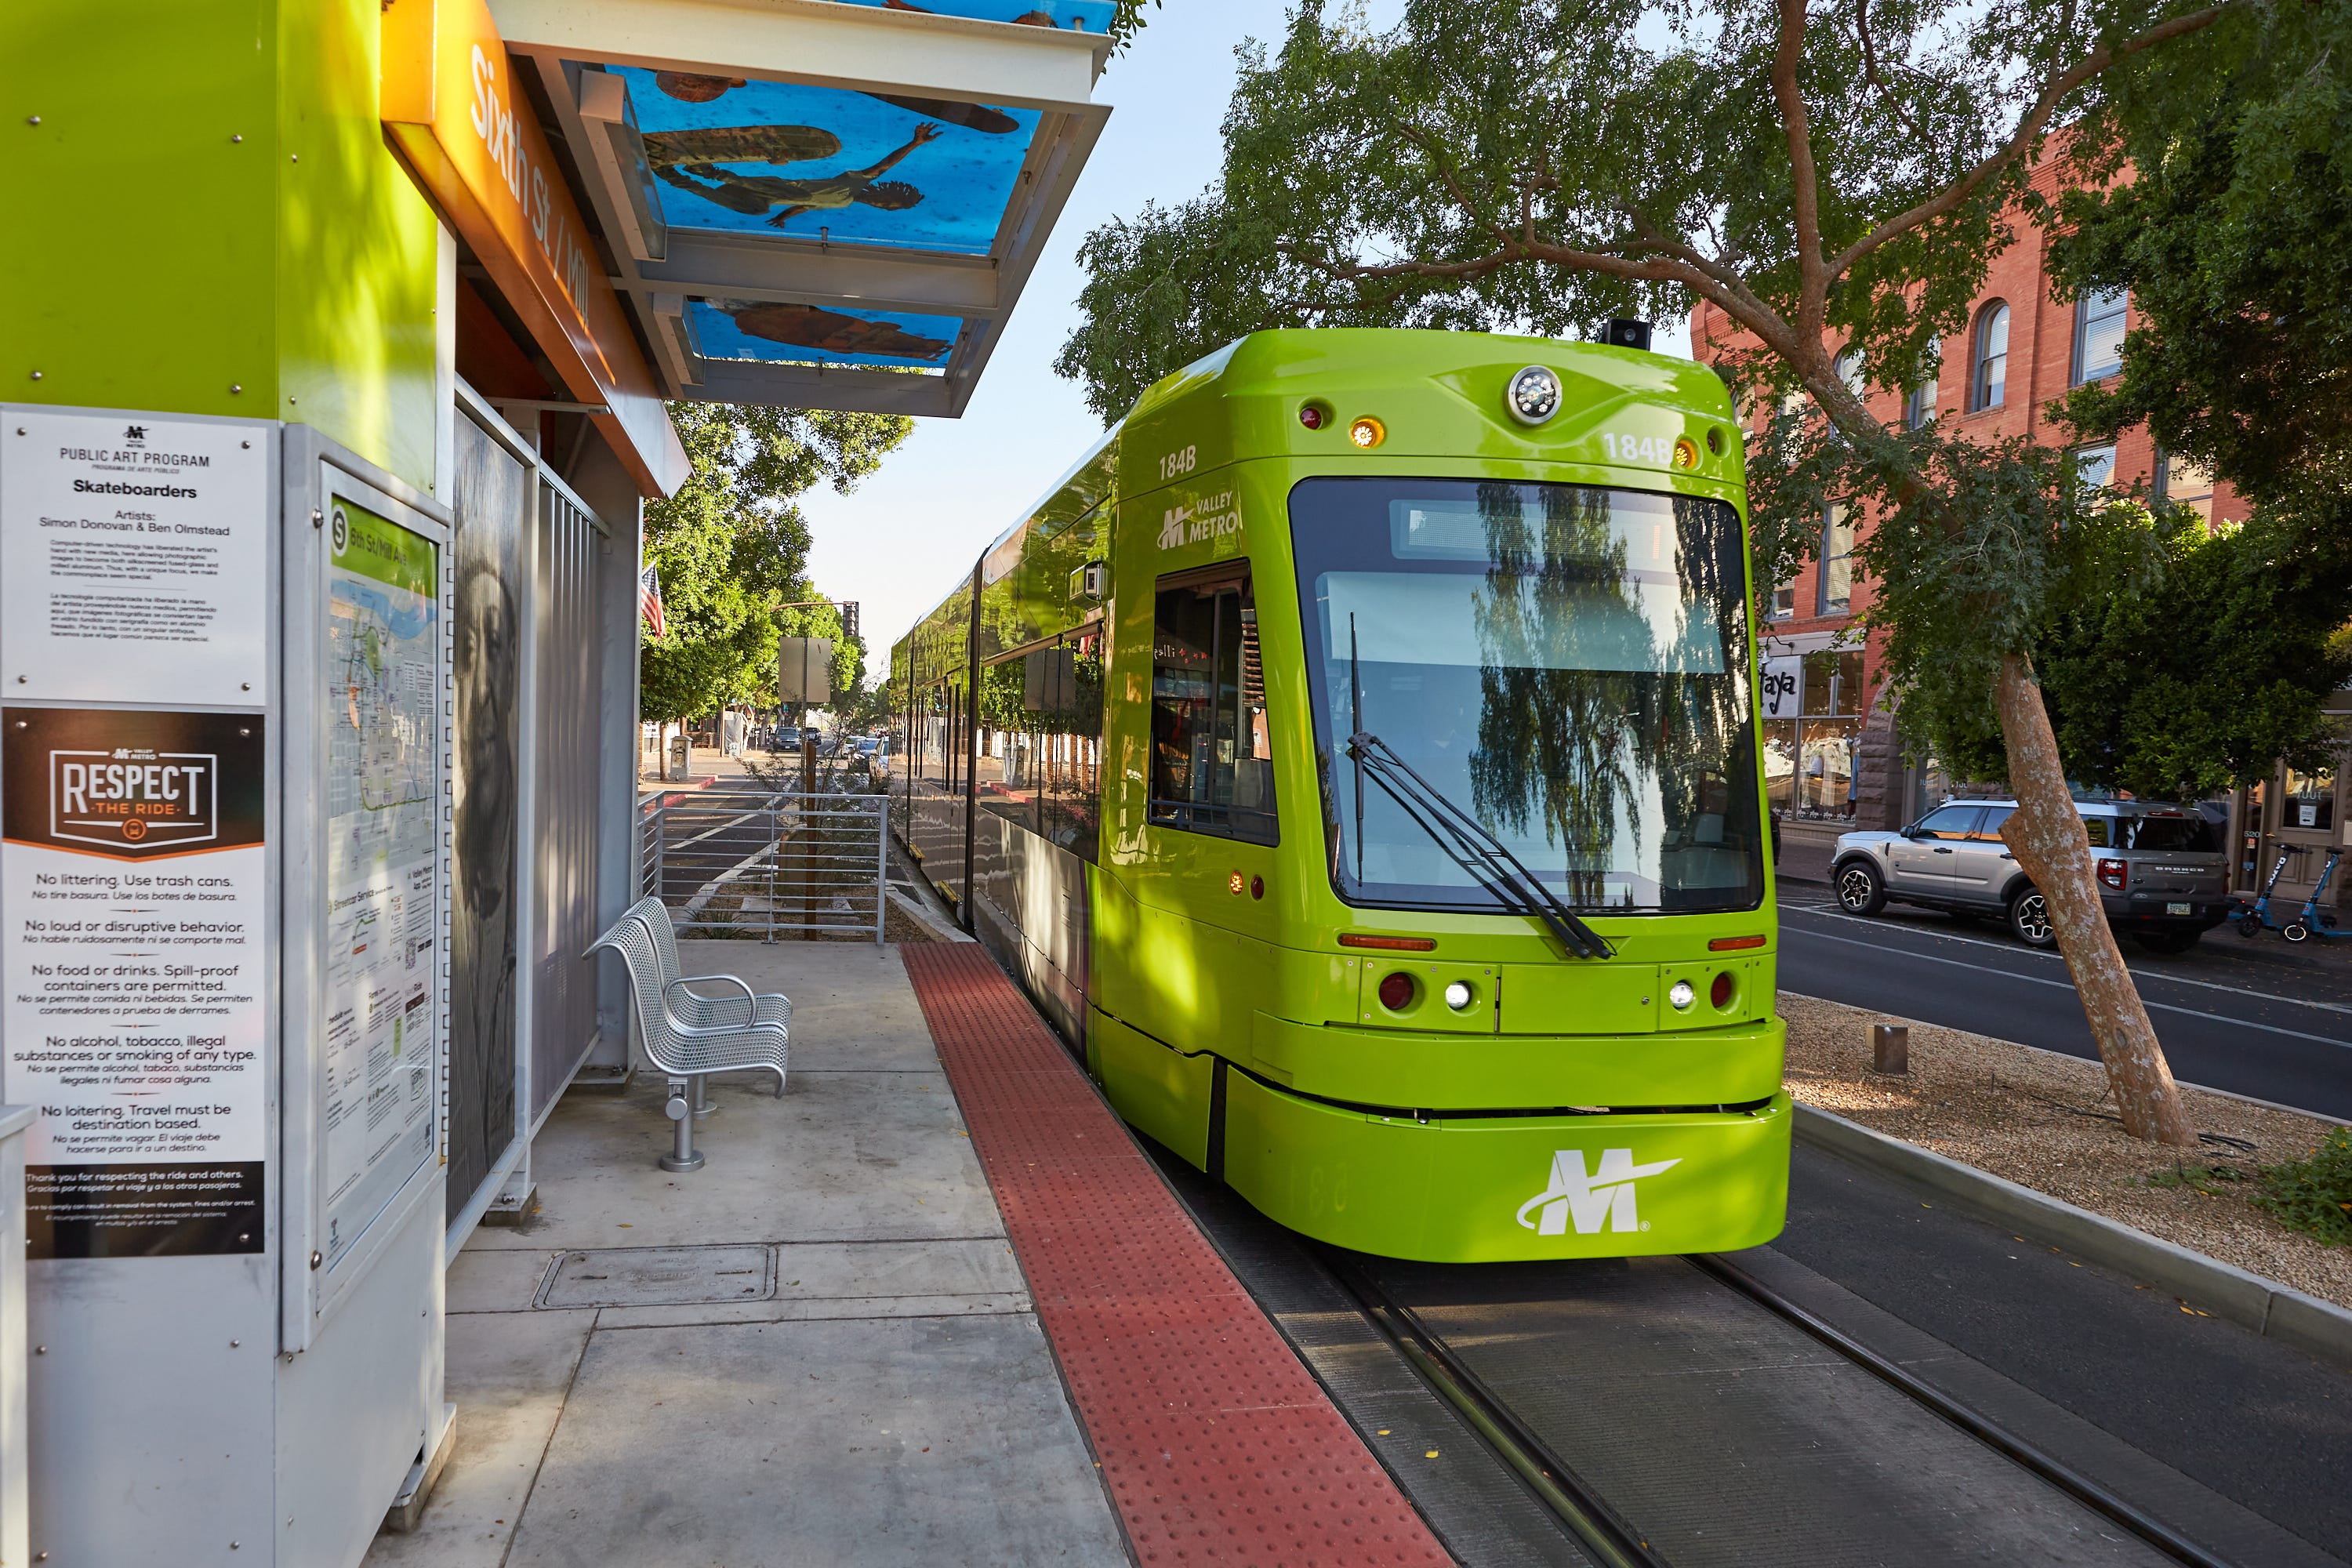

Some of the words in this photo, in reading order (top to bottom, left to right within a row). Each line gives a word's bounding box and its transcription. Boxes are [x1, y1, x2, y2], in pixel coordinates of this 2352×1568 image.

[470, 43, 528, 217] Sixth
[532, 165, 550, 258] St
[554, 214, 564, 281] /
[567, 231, 589, 328] Mill
[1603, 432, 1672, 464] 184B
[60, 447, 108, 462] PUBLIC
[112, 450, 138, 463] ART
[143, 452, 209, 467] PROGRAM
[1160, 445, 1196, 481] 184B
[73, 478, 198, 499] Skateboarders
[1196, 491, 1232, 514] VALLEY
[114, 510, 156, 521] Artists:
[39, 517, 77, 528] Simon
[80, 518, 132, 531] Donovan
[136, 521, 144, 532] &
[147, 521, 171, 532] Ben
[173, 523, 230, 536] Olmstead
[1189, 511, 1237, 543] METRO
[335, 517, 343, 543] S
[350, 527, 364, 549] 6th
[393, 546, 407, 566] Ave
[64, 763, 205, 815] RESPECT
[95, 802, 129, 814] THE
[135, 804, 176, 815] RIDE
[36, 873, 57, 885] No
[60, 873, 120, 889] littering.
[124, 874, 151, 886] Use
[155, 875, 194, 887] trash
[196, 877, 233, 887] cans.
[31, 890, 47, 899] No
[49, 891, 68, 899] tire
[112, 891, 132, 900] Use
[134, 891, 150, 900] los
[151, 891, 180, 901] botes
[181, 891, 197, 901] de
[25, 920, 45, 931] No
[49, 920, 82, 931] loud
[85, 923, 101, 931] or
[104, 920, 176, 935] disruptive
[180, 920, 244, 932] behavior.
[22, 935, 38, 943] No
[39, 935, 71, 943] hable
[71, 935, 146, 944] ruidosamente
[147, 935, 158, 943] ni
[172, 936, 223, 946] comporte
[31, 964, 53, 976] No
[56, 964, 89, 976] food
[93, 967, 110, 976] or
[112, 964, 160, 976] drinks.
[163, 964, 239, 978] Spill-proof
[43, 980, 120, 991] containers
[123, 982, 149, 991] are
[152, 979, 227, 993] permitted.
[16, 994, 32, 1003] No
[48, 995, 90, 1004] permite
[92, 994, 131, 1003] comida
[132, 994, 143, 1003] ni
[190, 993, 205, 1003] Se
[205, 994, 253, 1005] permiten
[38, 1006, 111, 1014] contenedores
[121, 1006, 162, 1016] prueba
[162, 1006, 177, 1014] de
[45, 1036, 67, 1047] No
[69, 1035, 122, 1047] alcohol,
[125, 1035, 183, 1047] tobacco,
[186, 1034, 226, 1051] illegal
[13, 1050, 94, 1062] substances
[96, 1051, 112, 1061] or
[115, 1049, 173, 1063] smoking
[176, 1049, 191, 1060] of
[193, 1051, 220, 1063] any
[222, 1050, 256, 1063] type.
[27, 1064, 42, 1073] No
[57, 1065, 100, 1074] permite
[183, 1062, 244, 1072] substancias
[60, 1076, 100, 1087] ilegales
[113, 1075, 147, 1084] fumar
[41, 1105, 62, 1116] No
[65, 1105, 125, 1119] loitering.
[128, 1104, 171, 1116] Travel
[174, 1105, 210, 1115] must
[213, 1103, 231, 1115] be
[71, 1119, 151, 1131] destination
[154, 1118, 201, 1129] based.
[52, 1134, 68, 1143] No
[82, 1134, 123, 1145] permite
[158, 1133, 169, 1142] El
[169, 1133, 194, 1144] viaje
[194, 1133, 220, 1142] debe
[65, 1145, 107, 1153] hacerse
[107, 1145, 133, 1155] para
[25, 1173, 56, 1182] Thank
[57, 1174, 77, 1184] you
[77, 1171, 94, 1181] for
[94, 1171, 147, 1182] respecting
[148, 1171, 166, 1180] the
[166, 1171, 187, 1180] ride
[187, 1170, 209, 1179] and
